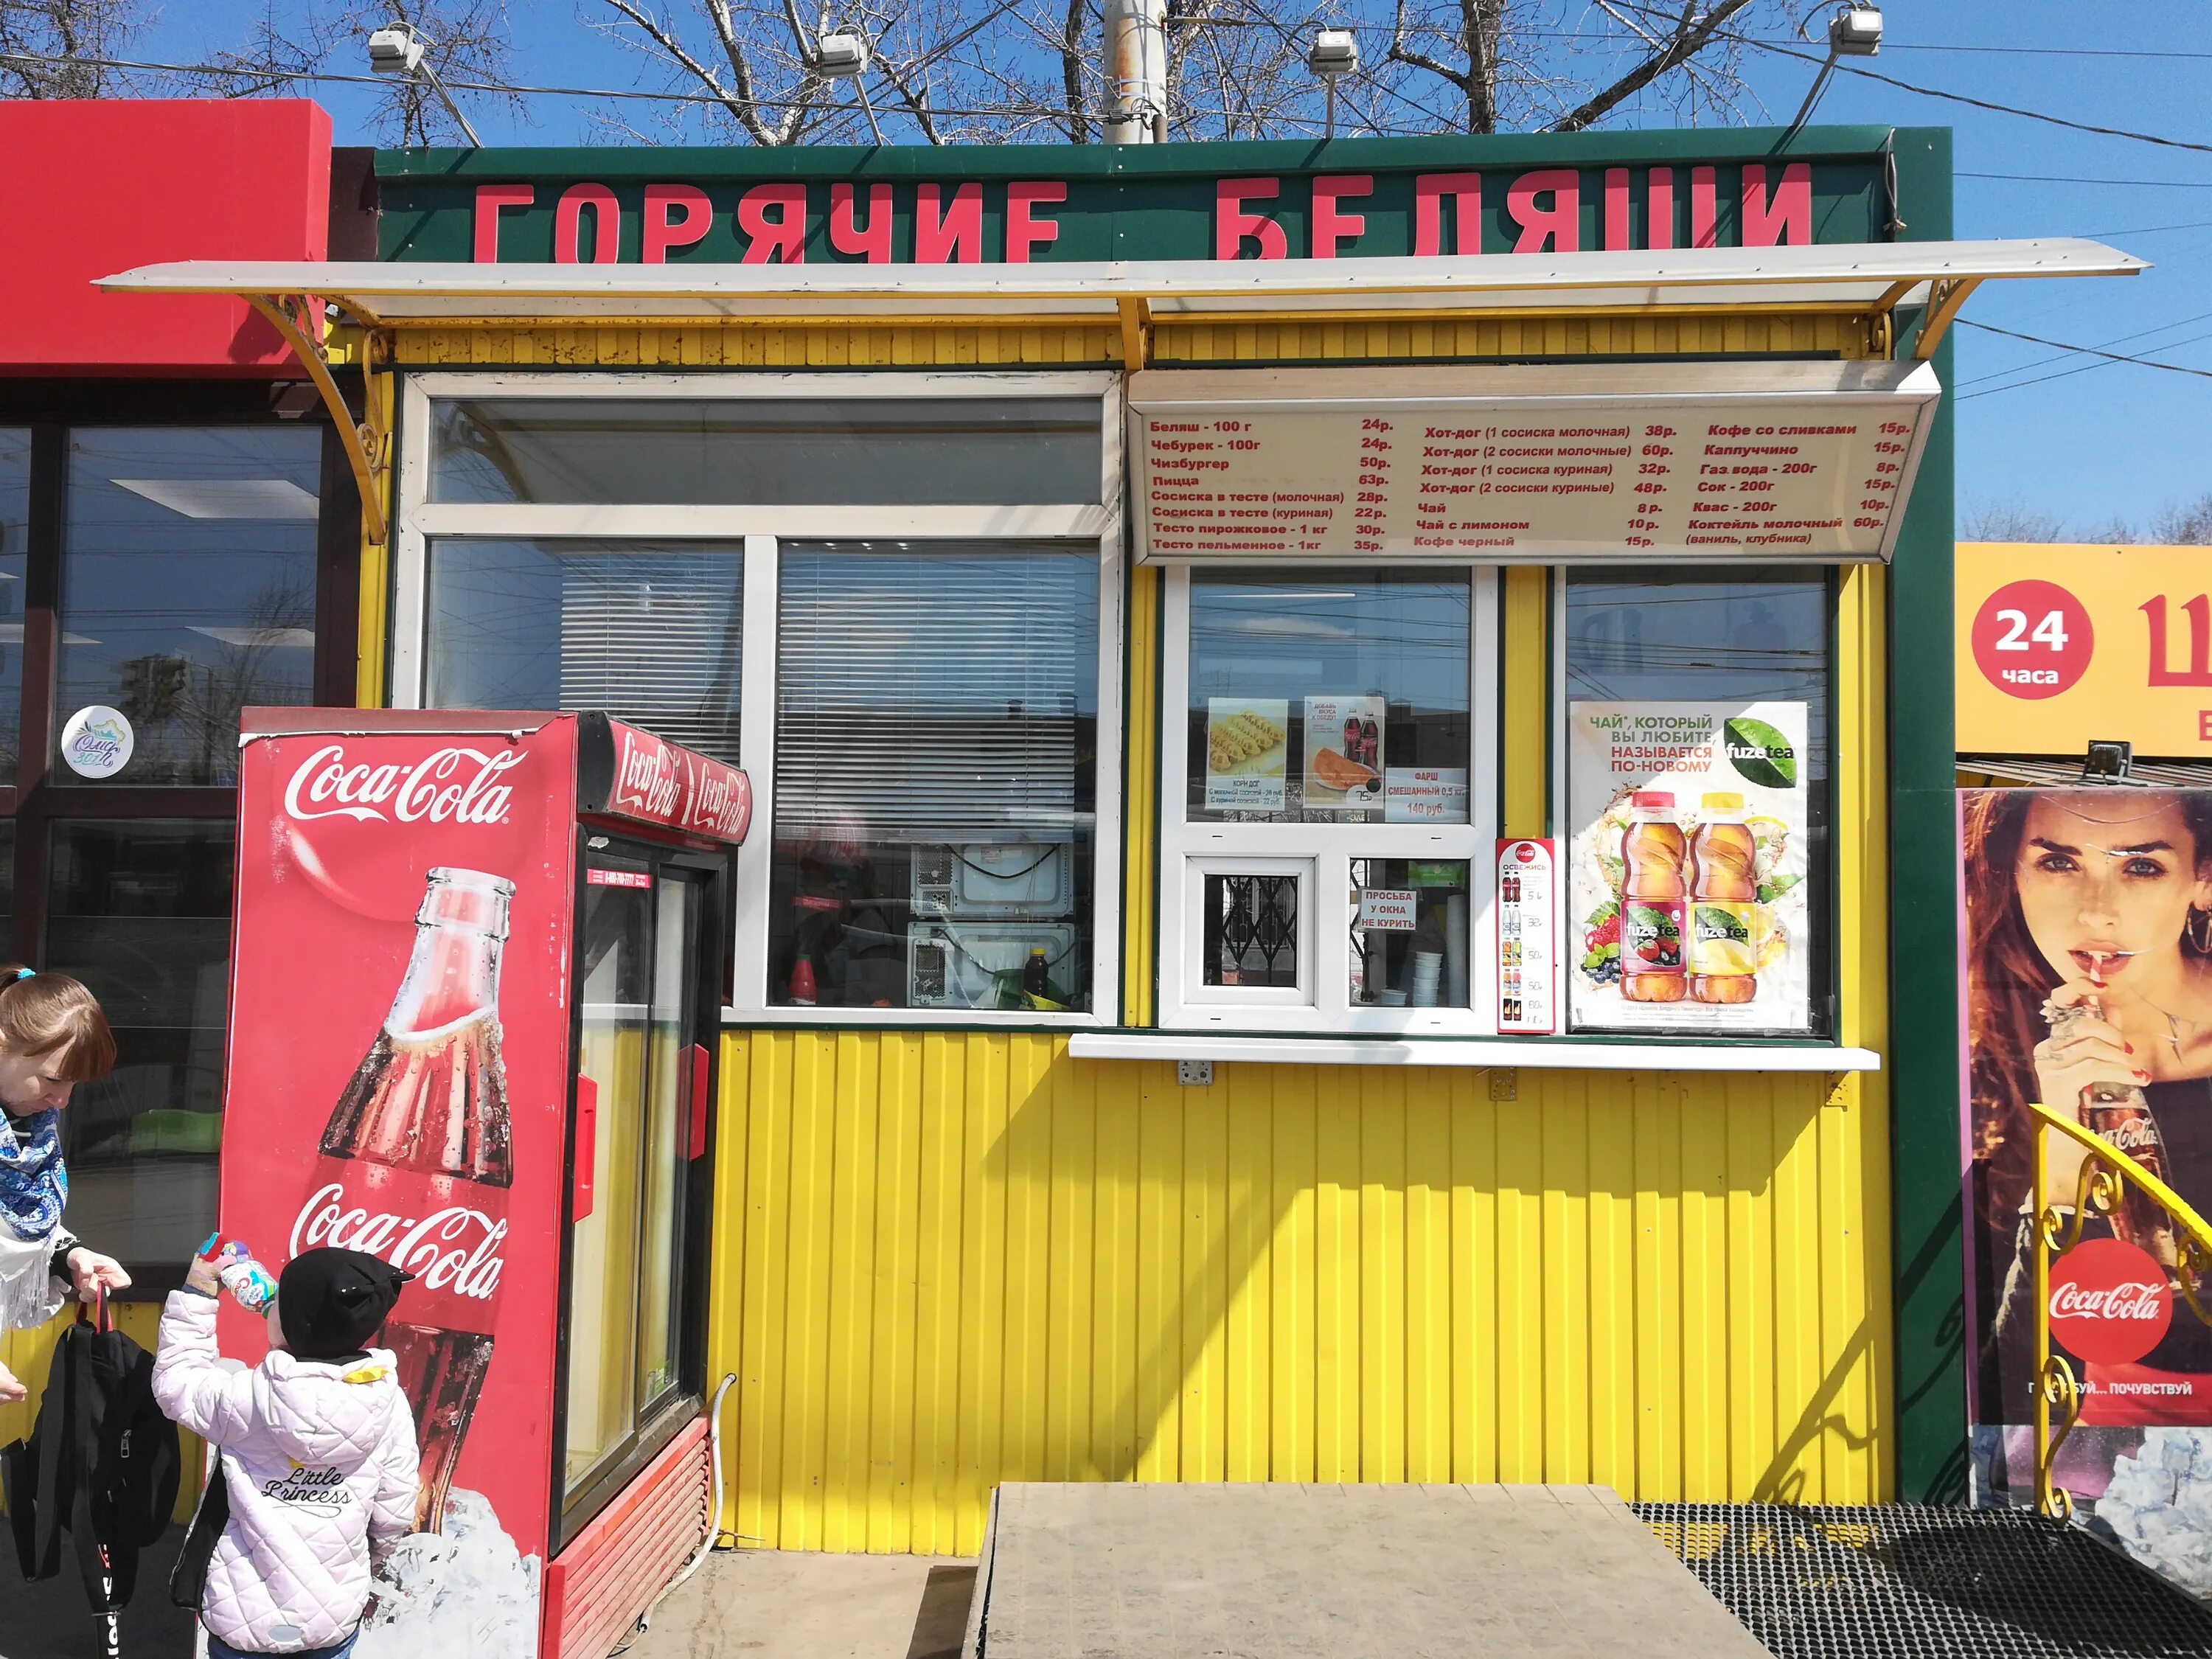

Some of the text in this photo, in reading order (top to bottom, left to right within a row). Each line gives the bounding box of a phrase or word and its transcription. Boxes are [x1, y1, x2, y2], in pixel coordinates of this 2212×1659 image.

[475, 162, 1812, 264] ГОРЯЧИЕ БЕЛЯШИ
[1150, 422, 1199, 431] Беляш
[1214, 422, 1239, 431] 100
[1363, 419, 1393, 432] 24р.
[1645, 425, 1677, 438] 38р.
[1708, 425, 1751, 437] Кофе
[1778, 426, 1857, 434] сливками
[1879, 422, 1910, 435] 15р.
[1425, 426, 1630, 440] Хот-дог (1 сосиска молочная)
[1152, 440, 1214, 452] Чебурек
[1228, 440, 1260, 450] 100г
[1362, 438, 1391, 451] 24р.
[1874, 442, 1905, 454] 15р.
[1423, 446, 1631, 459] Хот-дог (2 сосиски молочные)
[1643, 445, 1673, 457] 60р.
[1705, 445, 1798, 457] Каппуччино
[1151, 458, 1229, 470] Чизбургер
[1360, 457, 1391, 470] 50р.
[1638, 463, 1670, 476] 32р.
[1732, 467, 1767, 476] вода
[1781, 463, 1817, 473] 200г
[1877, 462, 1899, 473] 8р.
[1422, 465, 1477, 476] Хот-дог
[1482, 465, 1492, 477] (1
[1554, 464, 1612, 476] куриная)
[1153, 477, 1199, 487] Пицца
[1359, 474, 1388, 486] 63р.
[1865, 479, 1895, 490] 15р.
[1420, 483, 1475, 494] Хот-дог
[1480, 483, 1491, 495] (2
[1552, 482, 1614, 494] куриные)
[1698, 482, 1726, 492] Сок
[1739, 481, 1775, 491] 200г
[1152, 491, 1212, 501] Сосиска
[1273, 492, 1343, 504] (молочная)
[1357, 493, 1387, 504] 28р.
[1418, 504, 1446, 512] Чай
[1693, 502, 1729, 512] Квас
[1742, 502, 1777, 511] 200г
[1860, 499, 1889, 511] 10р.
[1152, 507, 1213, 518] Сосиска
[1273, 508, 1332, 519] (куриная)
[1153, 523, 1194, 532] Тесто
[1199, 526, 1287, 535] пирожковое
[1301, 525, 1307, 533] 1
[1416, 521, 1444, 529] Чай
[1688, 518, 1842, 529] Коктейль молочный
[1854, 518, 1884, 529] 60р.
[1356, 525, 1385, 536] 30р.
[1153, 540, 1193, 549] Тесто
[1298, 541, 1321, 549] 1кг
[1414, 537, 1514, 548] Кофе черный
[1625, 537, 1654, 547] 15р.
[1686, 533, 1811, 545] (ваниль, клубника)
[1354, 540, 1382, 552] 35р.
[1995, 609, 2068, 651] 24
[2002, 669, 2059, 684] часа
[1635, 714, 1712, 728] КОТОРЫЙ
[1612, 731, 1717, 745] ВЫ ЛЮБИТЕ,
[1612, 746, 1712, 758] НАЗЫВАЕТСЯ
[1611, 761, 1711, 772] ПО-НОВОМУ
[616, 731, 681, 817] Coca-Cola
[1415, 772, 1438, 781] ФАРШ
[285, 745, 529, 823] Coca-Cola
[1388, 785, 1440, 796] СМЕШАННЫЙ
[1441, 787, 1453, 797] 0,5
[694, 762, 745, 835] Coca-Cola
[1408, 802, 1445, 816] 140 руб.
[1366, 891, 1412, 901] ПРОСЬБА
[1380, 906, 1406, 914] ОКНА
[1362, 919, 1415, 928] НЕ КУРИТЬ
[289, 1183, 508, 1299] Coca-Cola
[2050, 1281, 2166, 1320] Coca-Cola
[2110, 1382, 2192, 1395] ПОЧУВСТВУЙ
[287, 1467, 344, 1486] Little
[261, 1481, 352, 1504] Princess
